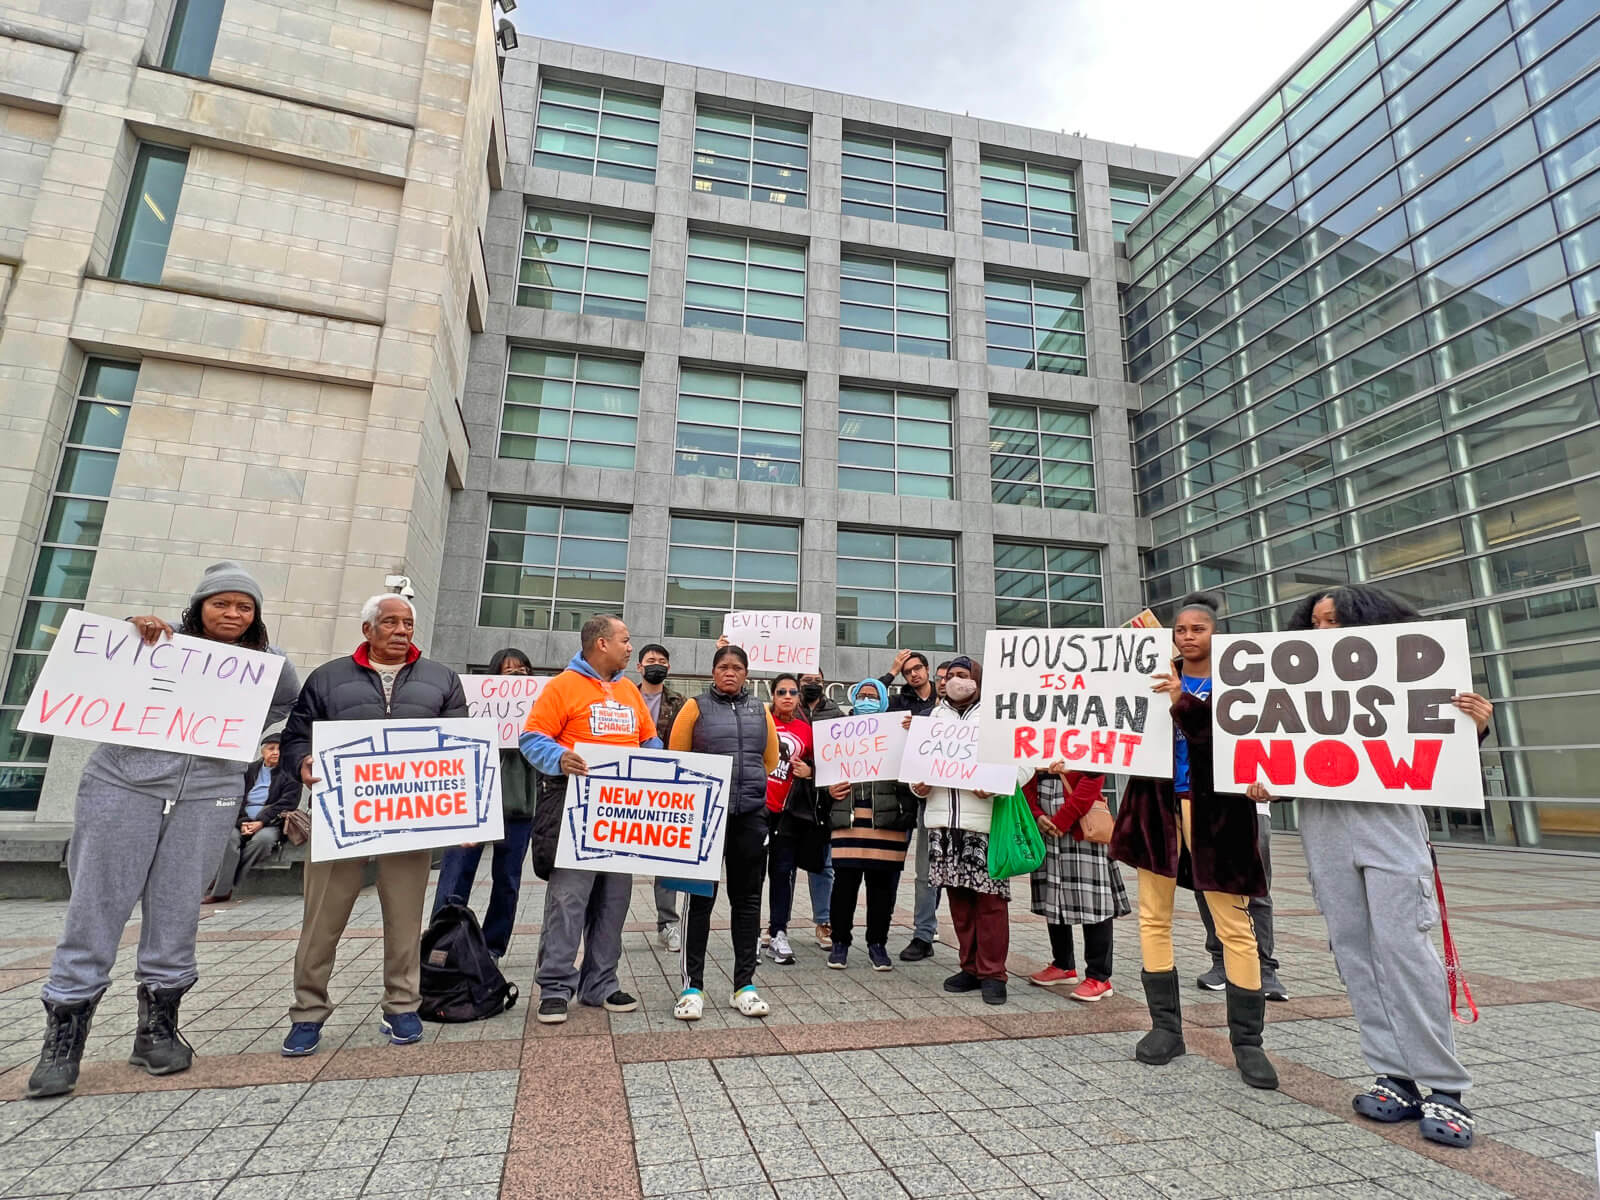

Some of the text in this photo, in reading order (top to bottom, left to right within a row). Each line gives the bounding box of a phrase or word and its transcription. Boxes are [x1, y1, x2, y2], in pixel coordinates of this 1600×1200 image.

[733, 614, 814, 630] EVICTION
[73, 622, 265, 686] EVICTION
[734, 642, 816, 665] OLENCE
[1000, 634, 1160, 674] HOUSING
[1219, 633, 1446, 687] GOOD
[481, 678, 538, 698] GOOD
[1039, 674, 1086, 690] IS A
[39, 689, 246, 748] VIOLENCE
[467, 699, 535, 719] CAUS
[995, 694, 1149, 733] HUMAN
[1216, 685, 1457, 737] CAUSE
[597, 722, 631, 732] CHANGE
[831, 717, 879, 740] GOOD
[821, 735, 889, 762] CAUSE
[919, 739, 976, 759] CAUS
[1013, 725, 1143, 768] RIGHT
[354, 758, 465, 783] NEW YORK
[840, 758, 883, 778] NOW
[930, 758, 978, 780] NOW
[1233, 739, 1443, 790] NOW
[354, 778, 459, 797] COMMUNITIES
[599, 786, 696, 811] NEW YORK
[353, 791, 468, 824] CHANGE
[596, 806, 687, 824] COMMUNITIES
[592, 819, 694, 849] CHANGE
